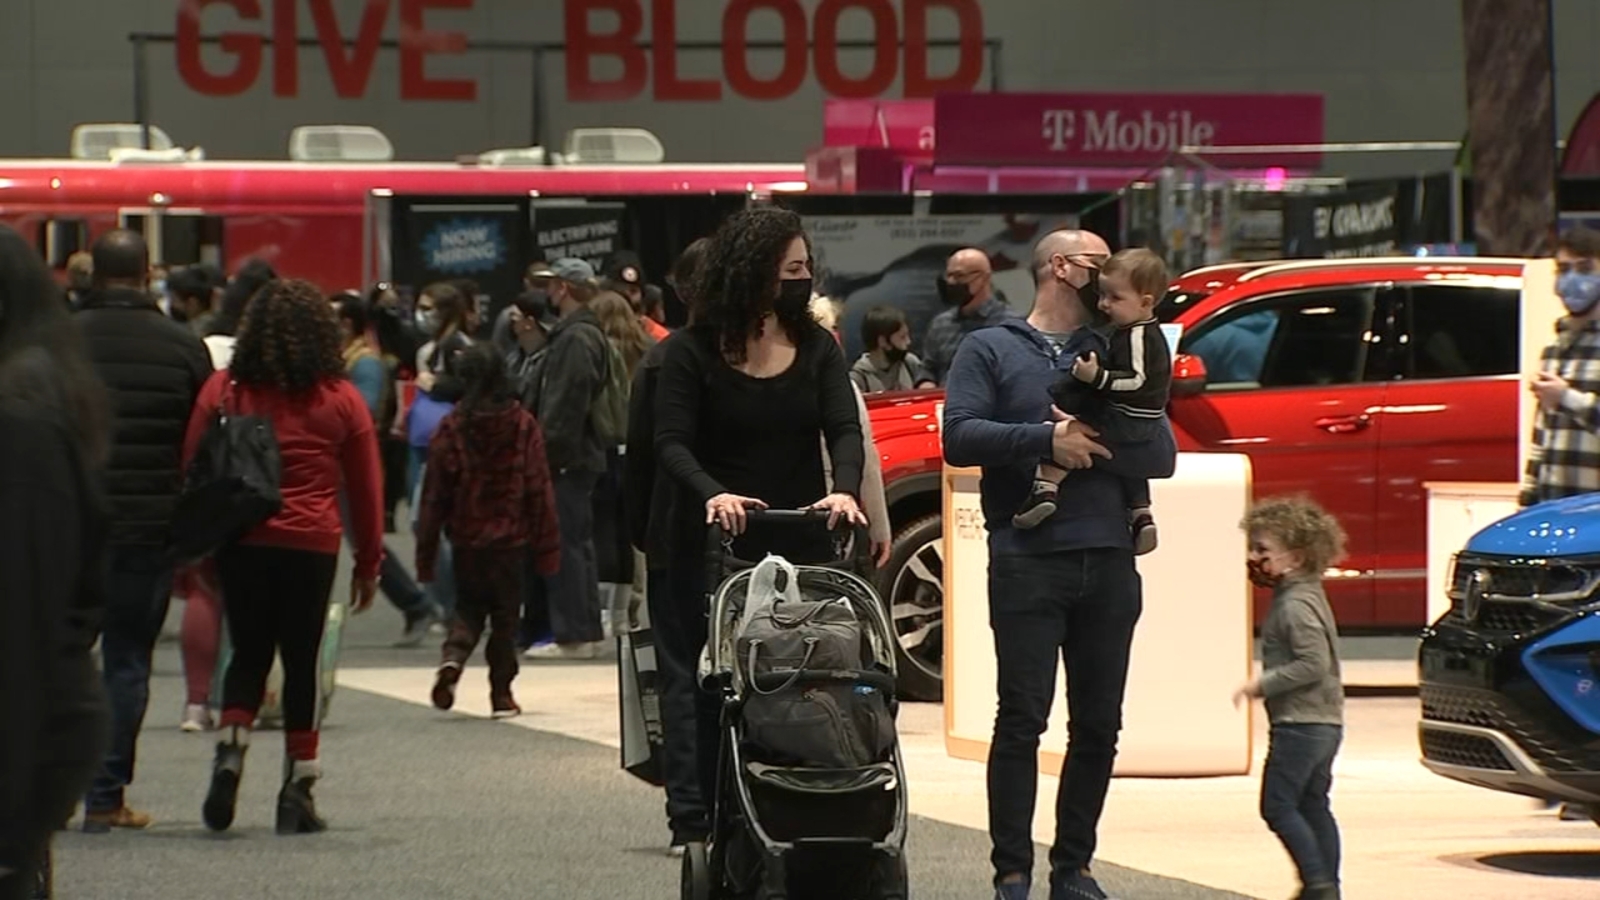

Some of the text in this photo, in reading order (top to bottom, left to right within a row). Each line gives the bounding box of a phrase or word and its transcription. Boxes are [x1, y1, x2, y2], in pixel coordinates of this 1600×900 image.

[176, 0, 984, 102] GIVE BLOOD
[1082, 109, 1214, 152] Mobile
[440, 225, 489, 247] NOW
[537, 219, 618, 246] ELECTRIFYING
[432, 241, 497, 265] HIRING
[544, 238, 613, 262] THE FUTURE
